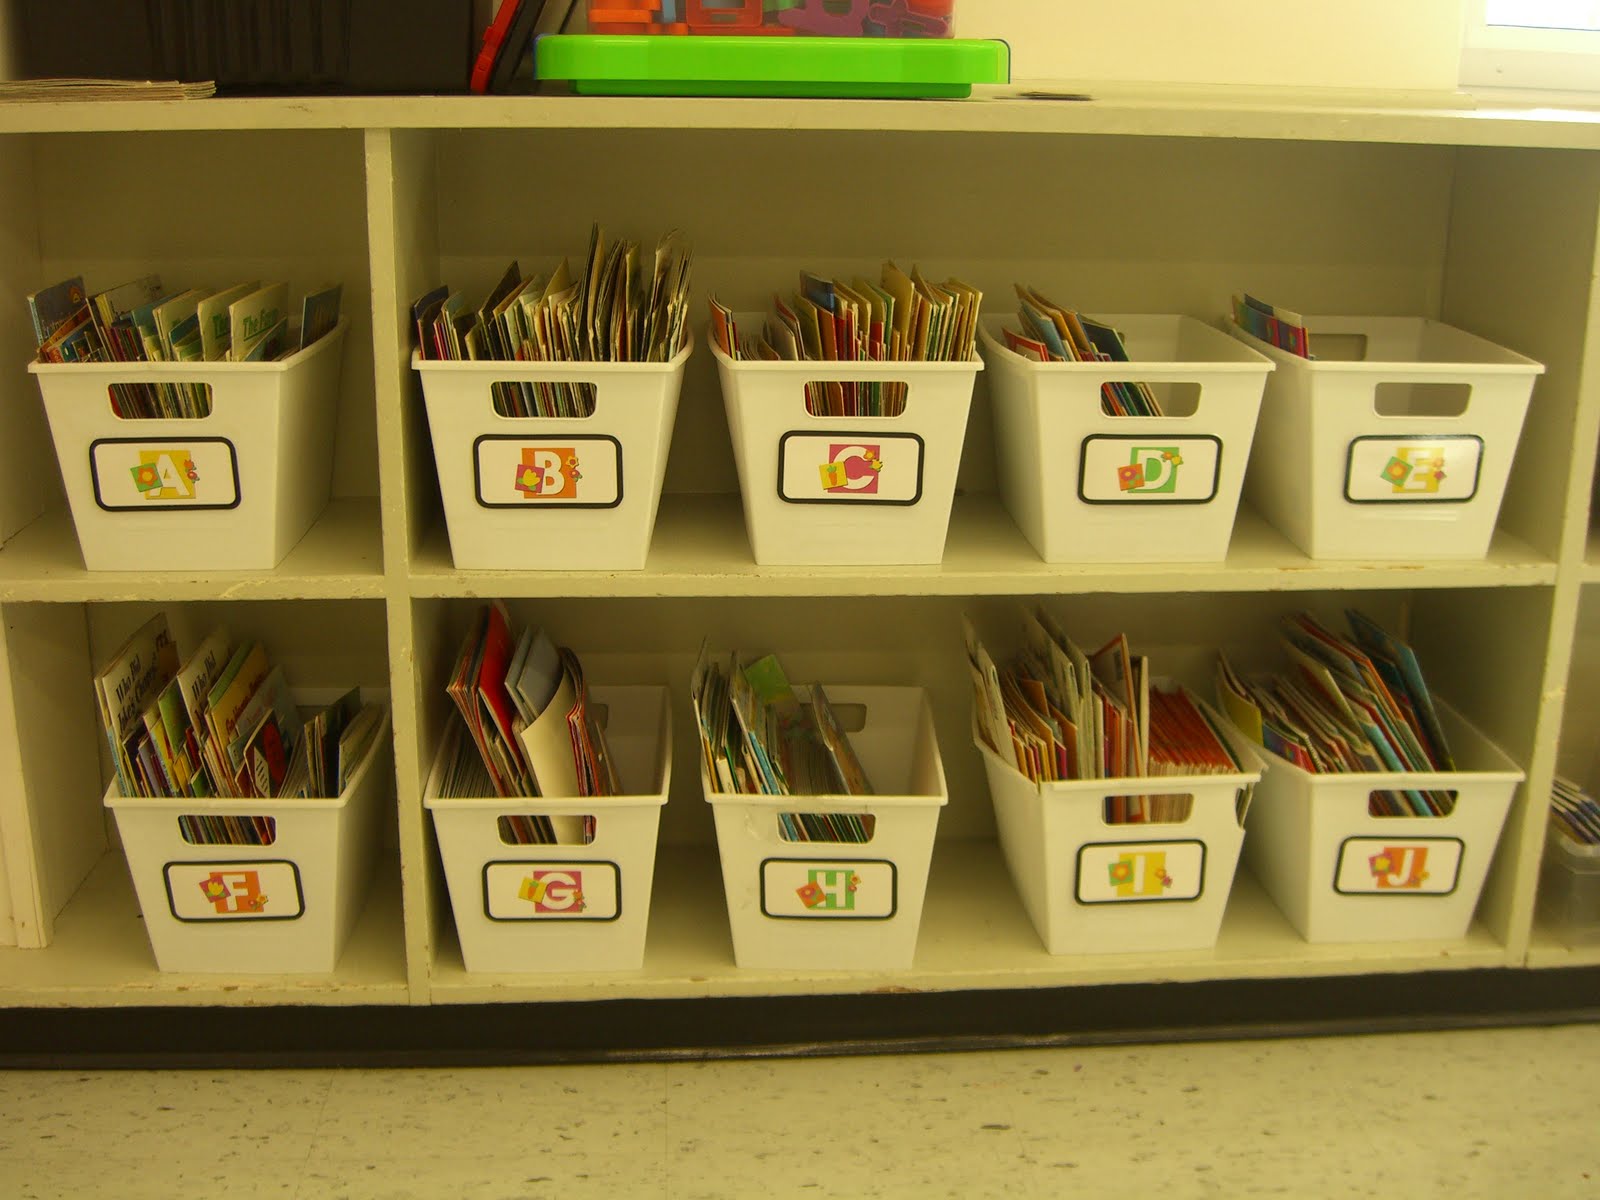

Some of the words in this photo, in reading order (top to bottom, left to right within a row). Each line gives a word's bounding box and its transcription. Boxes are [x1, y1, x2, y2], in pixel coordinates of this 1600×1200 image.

[150, 453, 191, 497] A
[535, 450, 565, 495] B
[833, 446, 875, 489] C
[1136, 449, 1172, 490] D
[1404, 450, 1433, 489] E
[1134, 855, 1145, 893] I
[1388, 849, 1415, 886] J
[222, 874, 250, 910] F
[538, 872, 577, 910] G
[816, 872, 846, 907] H
